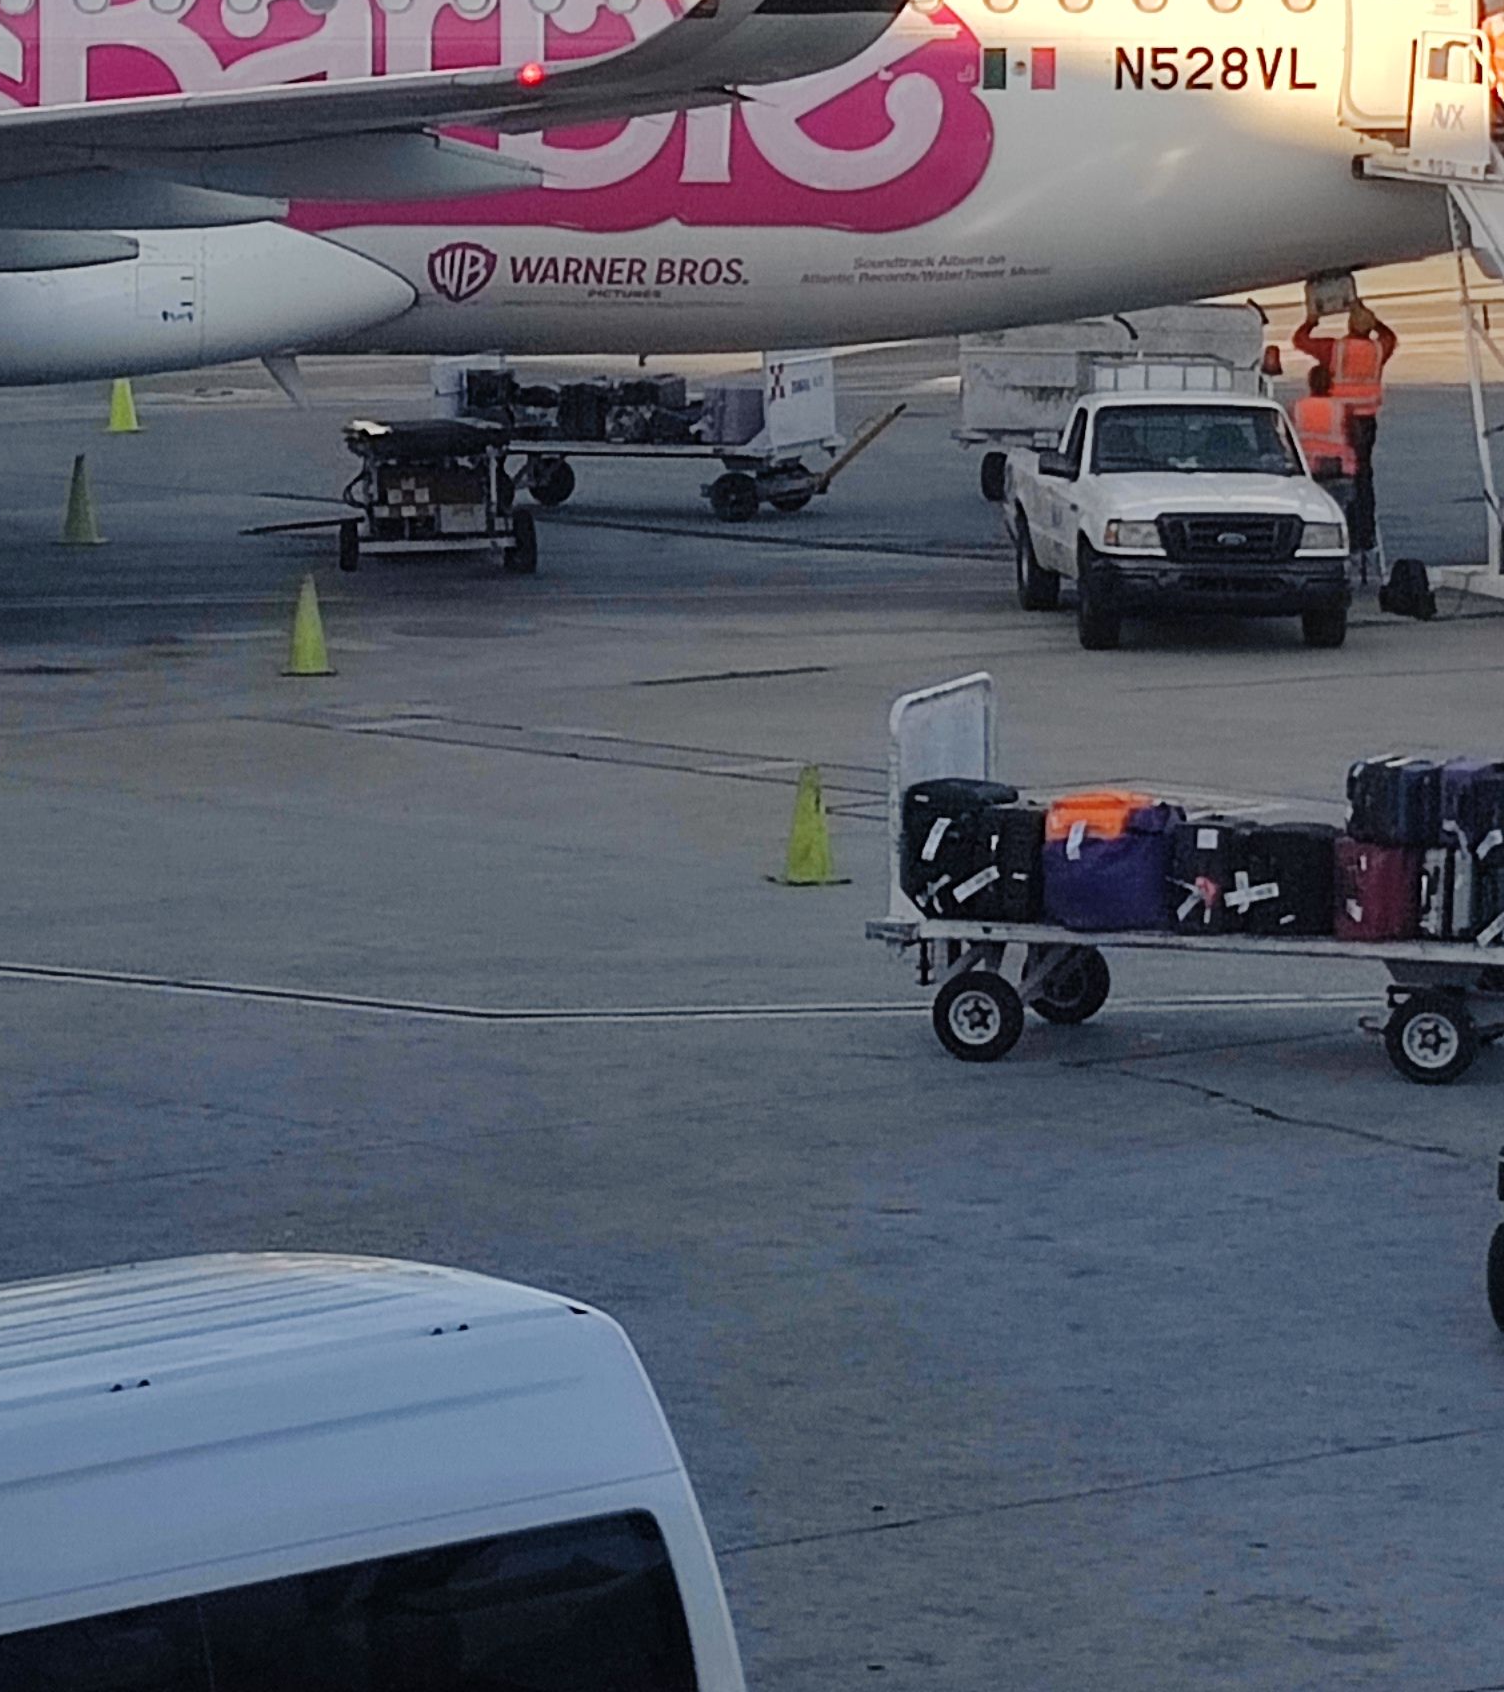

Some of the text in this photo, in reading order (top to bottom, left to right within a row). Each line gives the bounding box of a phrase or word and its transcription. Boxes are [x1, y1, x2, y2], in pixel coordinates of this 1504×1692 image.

[1115, 47, 1317, 91] N528VL
[430, 244, 495, 300] WB
[509, 255, 750, 287] WARNER BROS.
[853, 256, 935, 270] Soundtrack
[938, 255, 985, 268] Album
[800, 272, 855, 284] Atlantic
[587, 289, 662, 299] PICTURES
